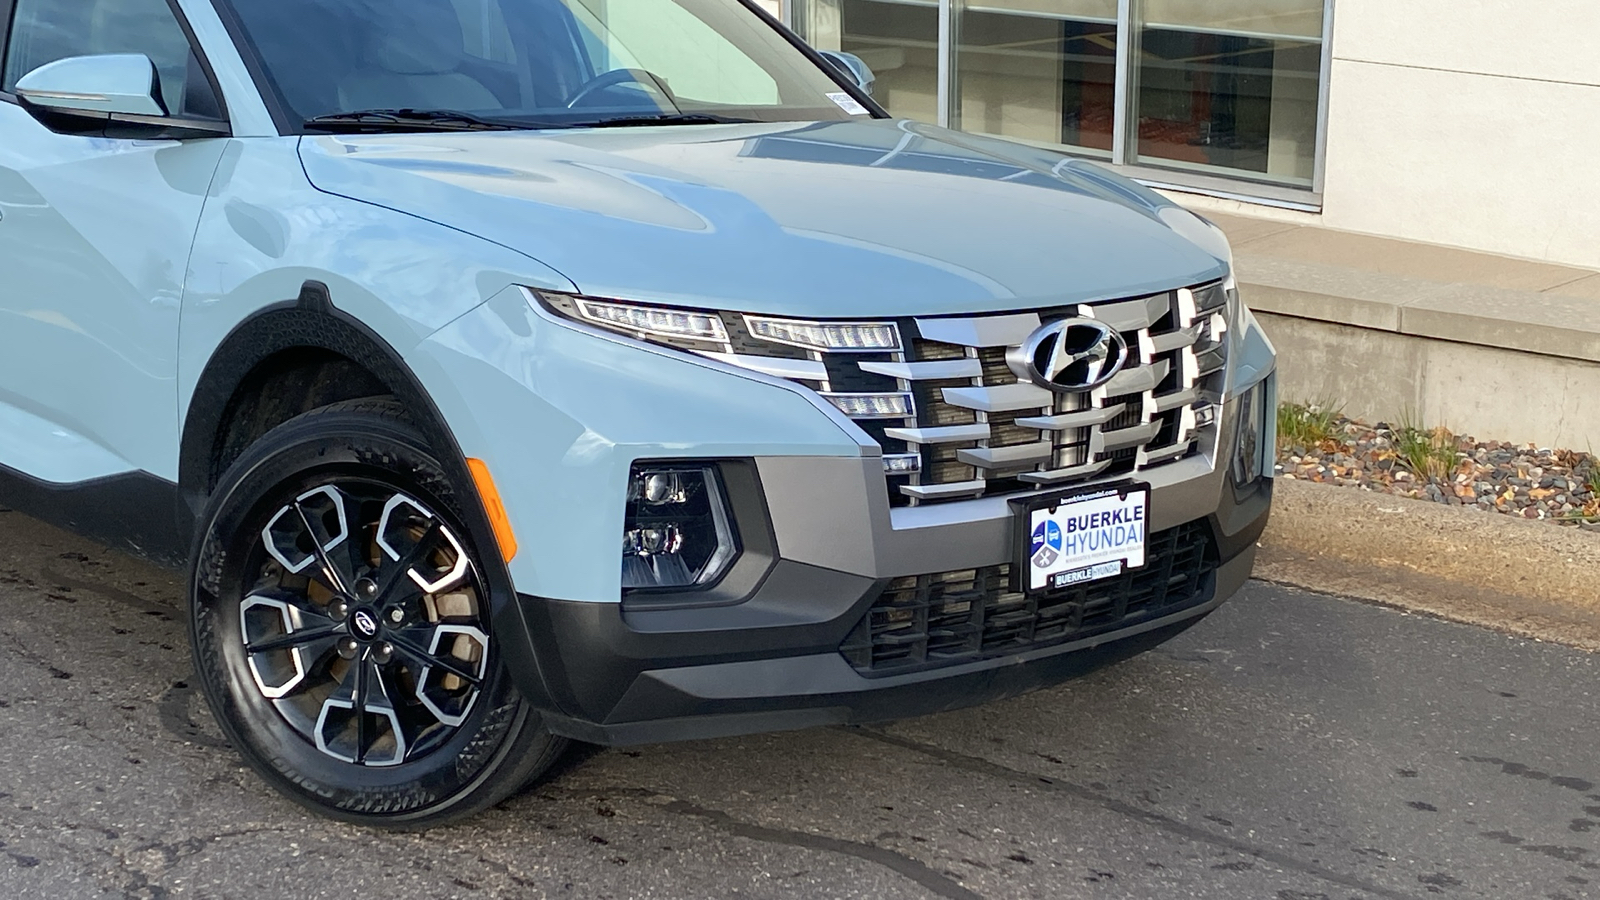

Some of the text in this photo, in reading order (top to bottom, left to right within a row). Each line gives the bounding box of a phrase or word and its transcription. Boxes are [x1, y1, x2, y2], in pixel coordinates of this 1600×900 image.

[1067, 505, 1143, 533] BUERKLE
[1066, 523, 1143, 556] HYUNDAI
[1056, 562, 1119, 585] BUERKLE HYUNDAI
